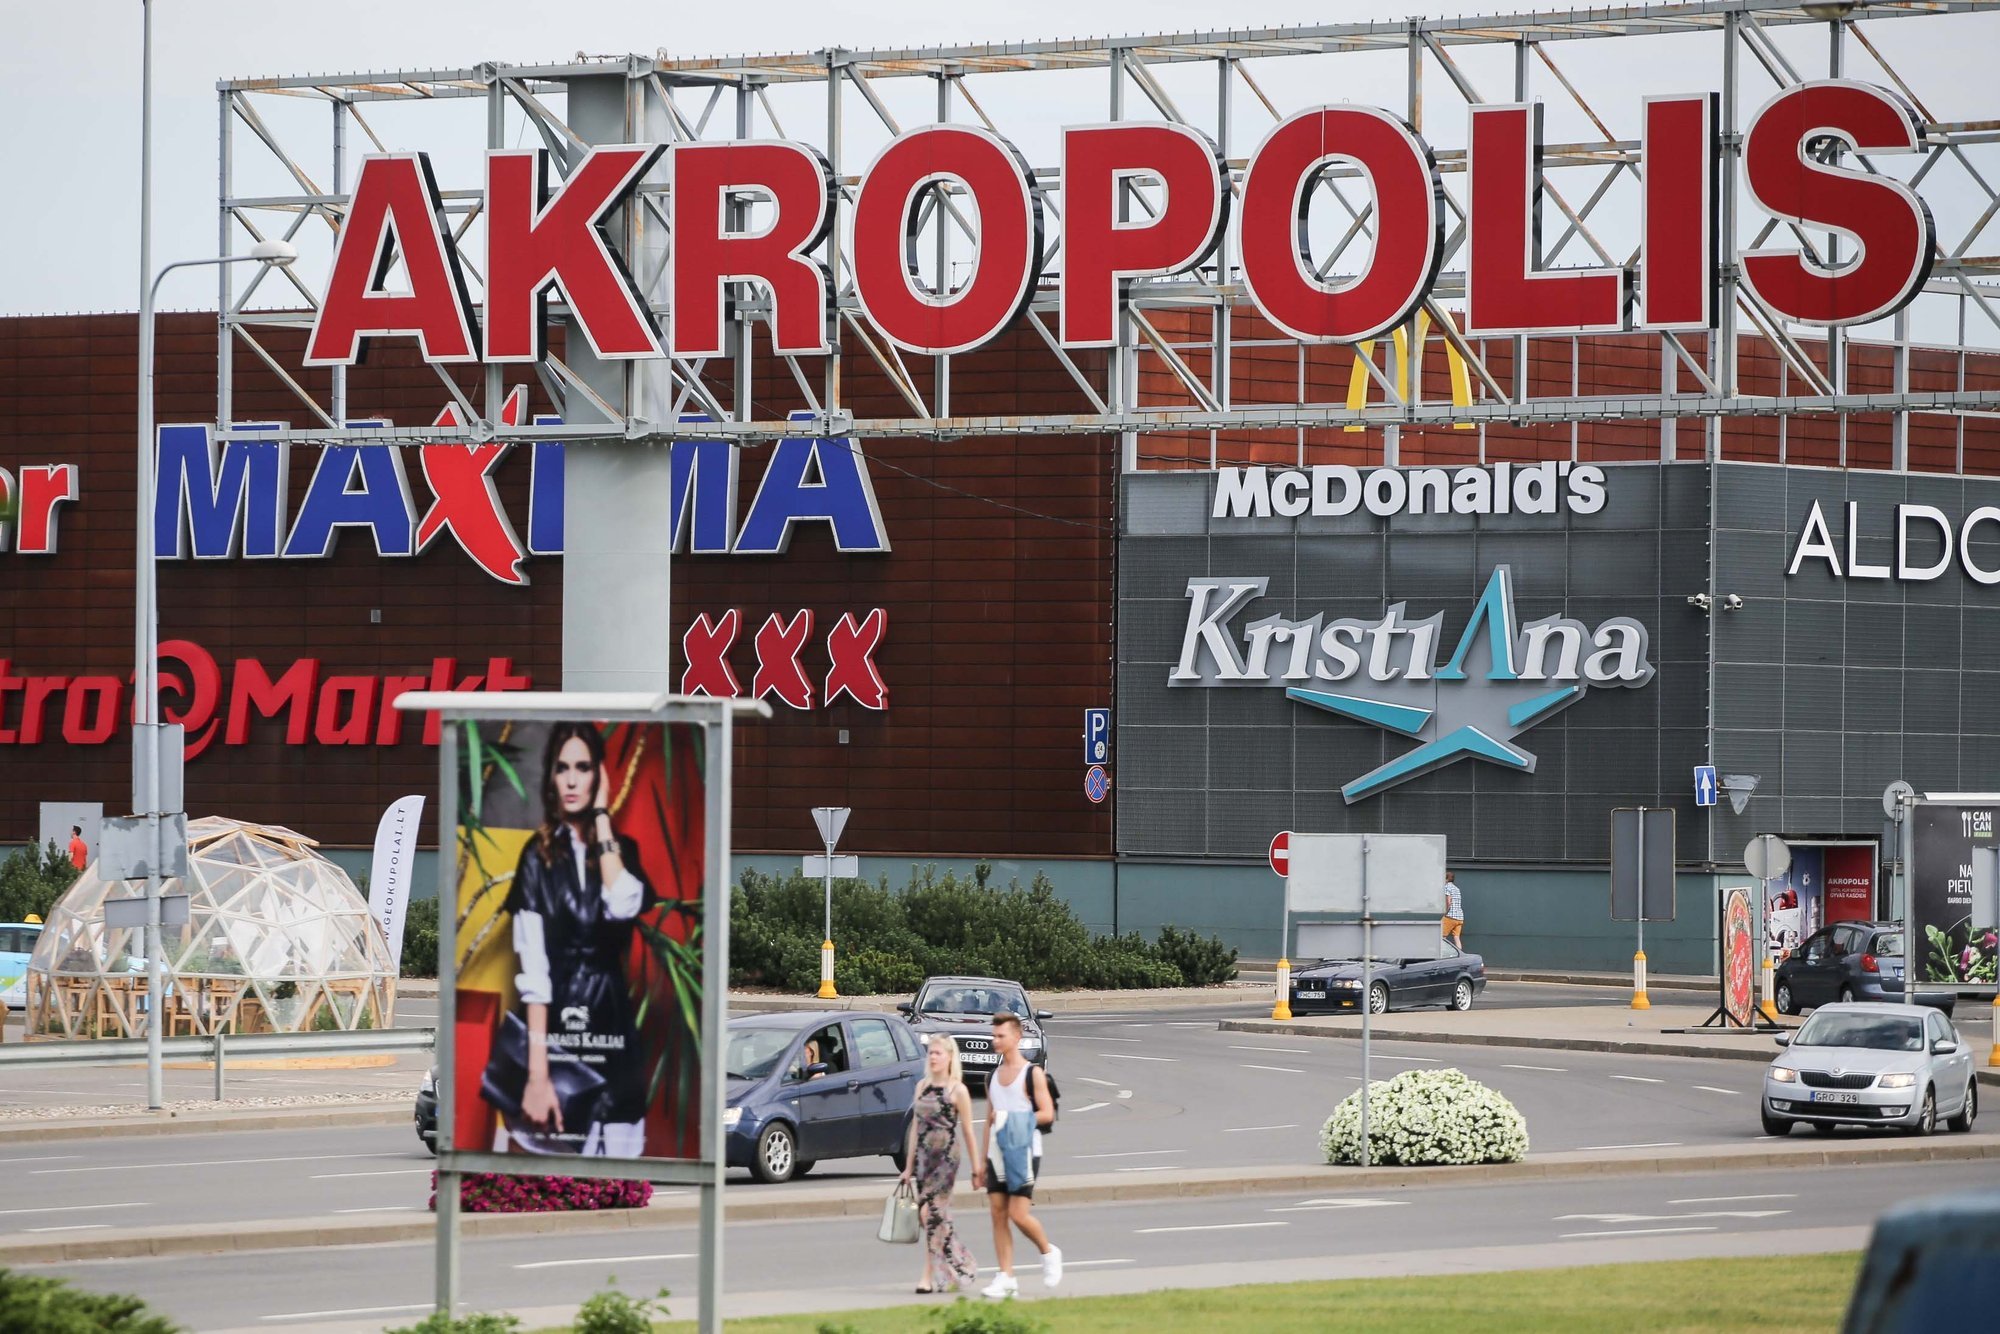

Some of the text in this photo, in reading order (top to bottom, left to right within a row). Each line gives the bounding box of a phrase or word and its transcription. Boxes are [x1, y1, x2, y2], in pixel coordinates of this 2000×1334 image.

[303, 78, 1937, 368] AKROPOLIS
[155, 383, 893, 586] MAXIMA
[1212, 461, 1609, 518] McDonald's
[0, 463, 79, 554] r
[1092, 713, 1105, 742] P
[1973, 812, 1992, 821] CAN
[1973, 822, 1992, 831] CAN
[1959, 864, 1973, 878] NA
[982, 1054, 996, 1062] 415
[1815, 1092, 1857, 1103] GRO 329
